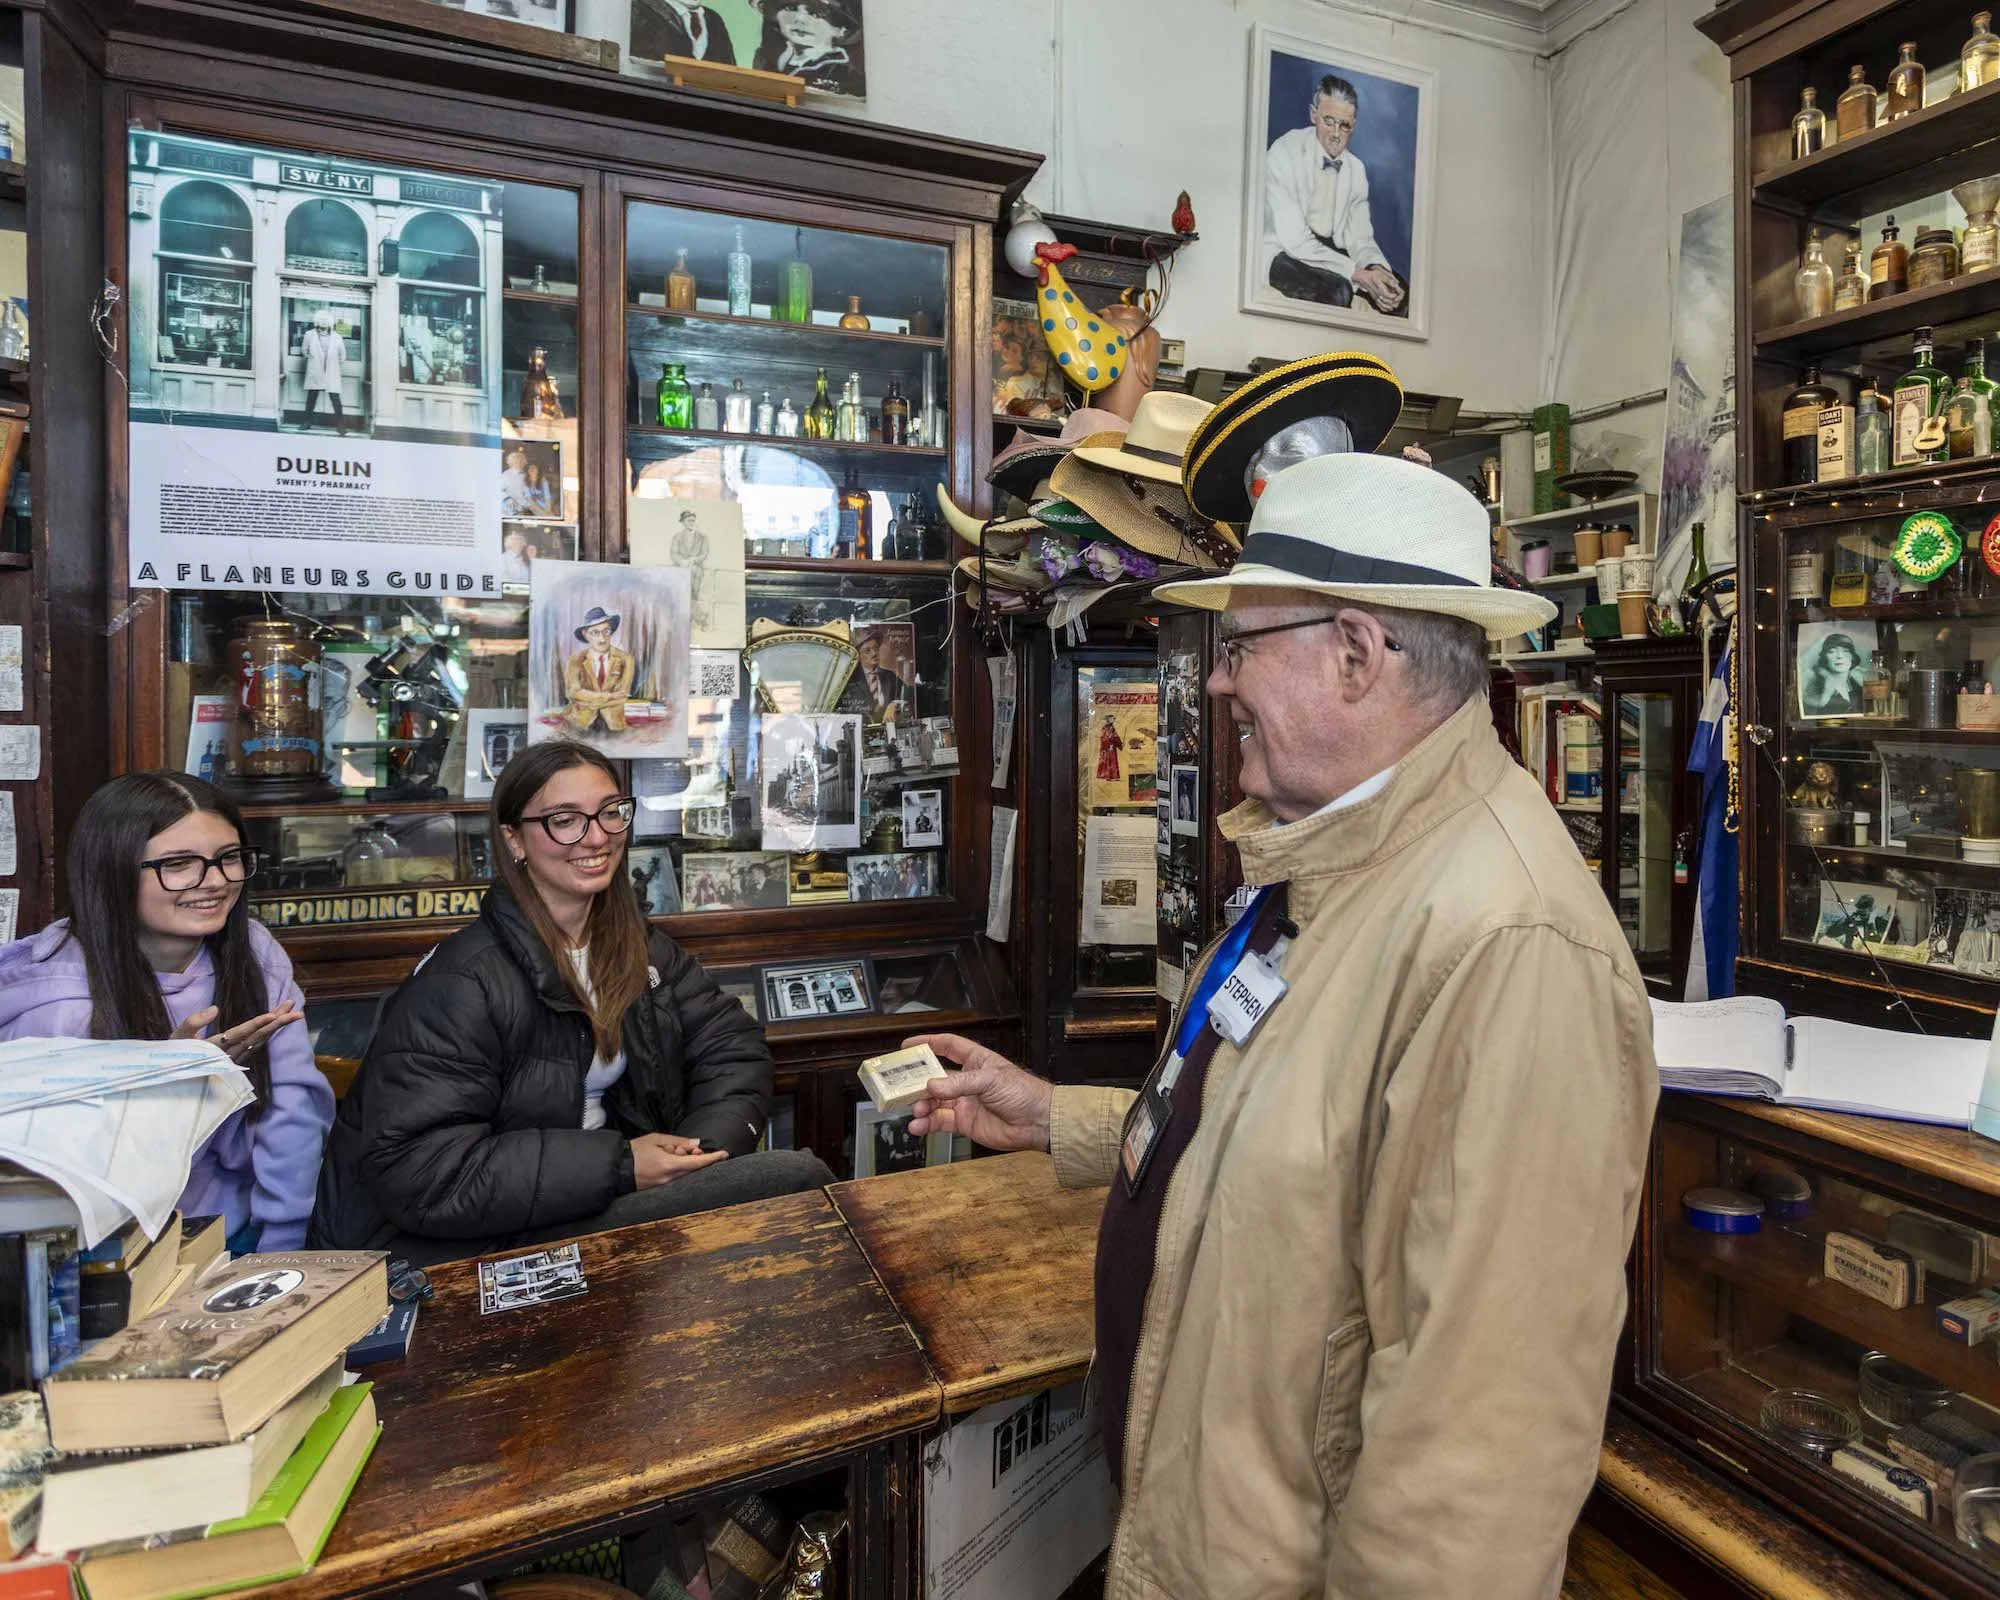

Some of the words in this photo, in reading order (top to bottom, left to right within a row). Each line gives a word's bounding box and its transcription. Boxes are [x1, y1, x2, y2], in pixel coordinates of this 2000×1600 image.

[276, 457, 372, 478] DUBLIN
[276, 478, 318, 489] SWENY'S
[320, 480, 372, 491] PHARMACY
[138, 562, 159, 581] A
[177, 563, 371, 588] FLANEURS
[387, 571, 495, 593] GUIDE
[886, 628, 909, 637] James
[888, 636, 910, 644] Joyce
[1224, 975, 1265, 1022] STEPHEN
